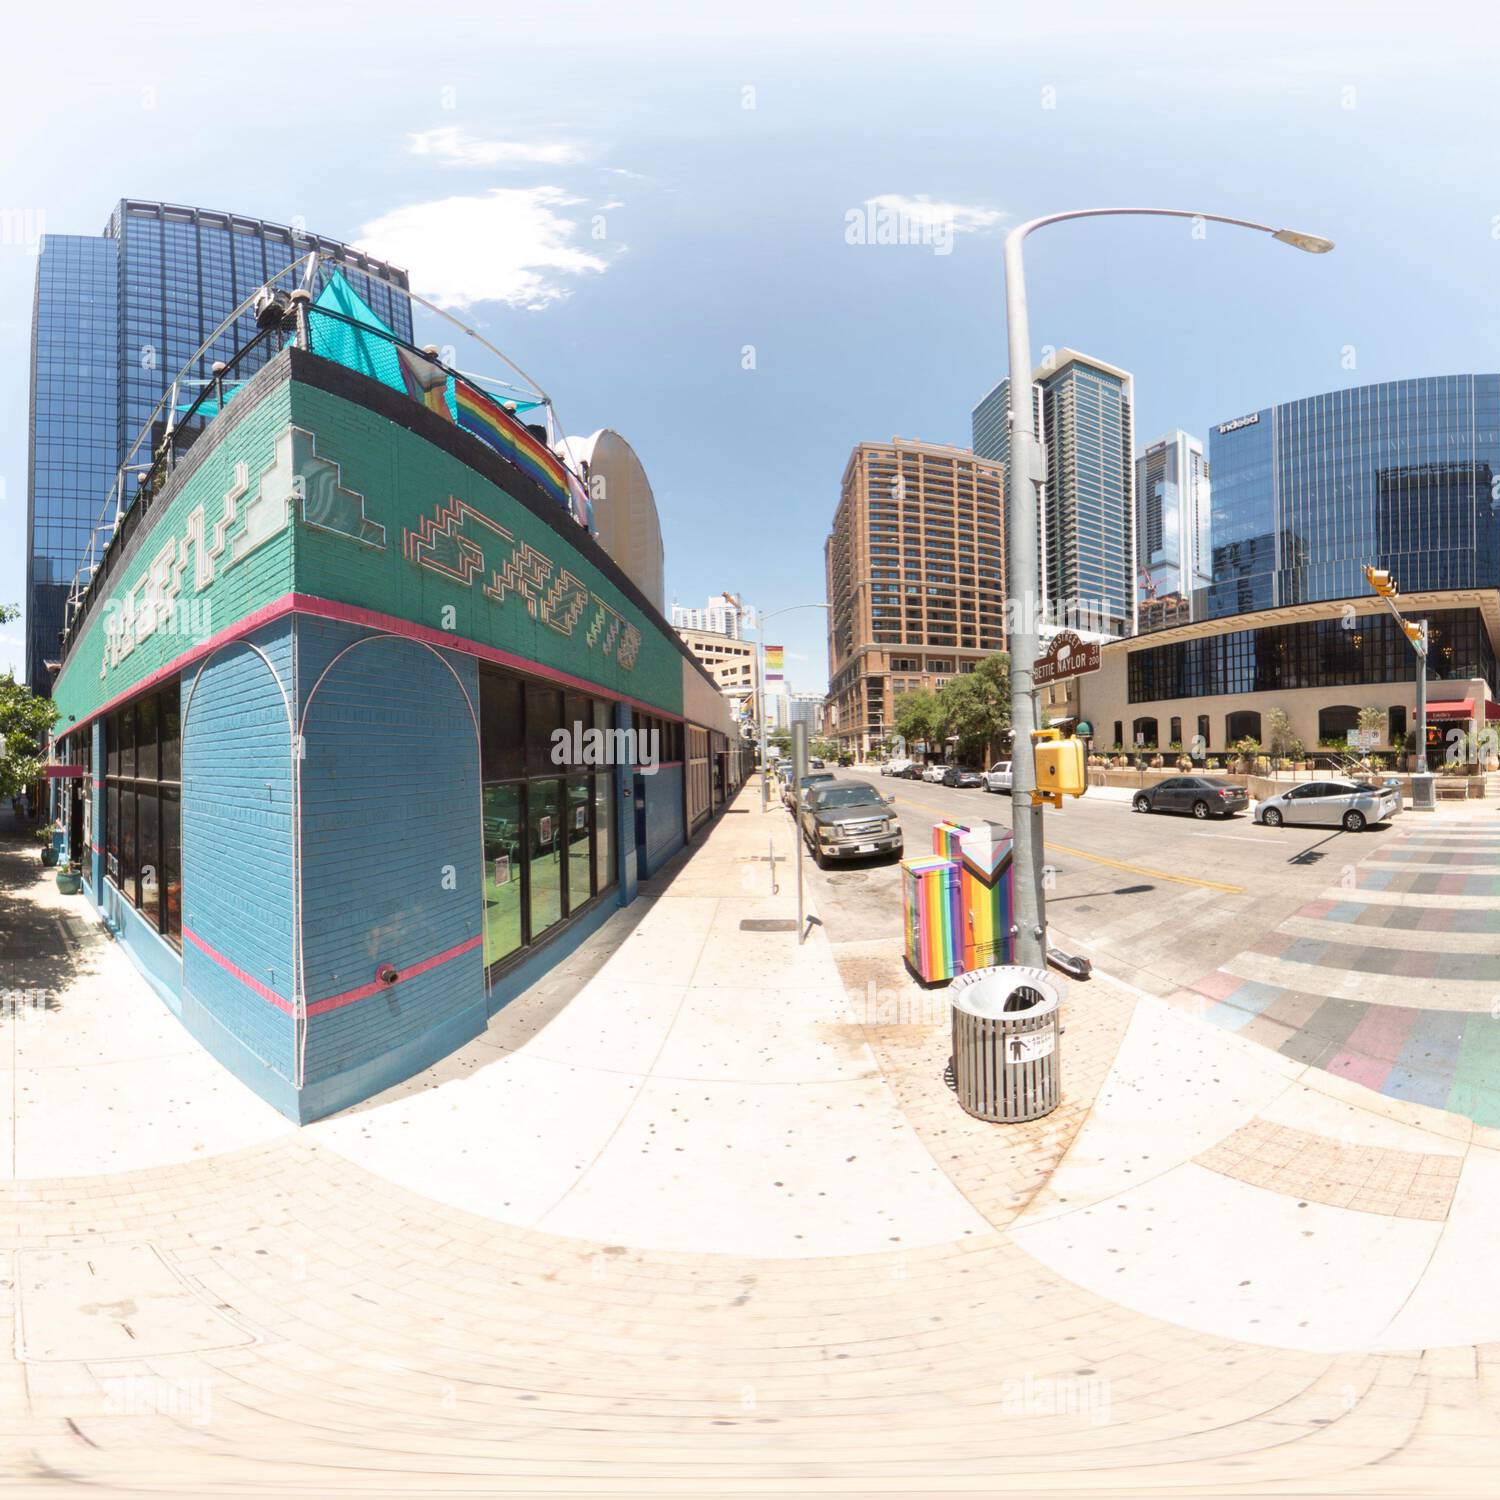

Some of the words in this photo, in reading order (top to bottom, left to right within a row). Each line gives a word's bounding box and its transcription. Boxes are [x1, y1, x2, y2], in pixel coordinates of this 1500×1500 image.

[1091, 645, 1099, 655] ST
[1088, 655, 1100, 666] 200
[1034, 662, 1055, 680] BETTIE
[1057, 653, 1087, 673] NAYLOR
